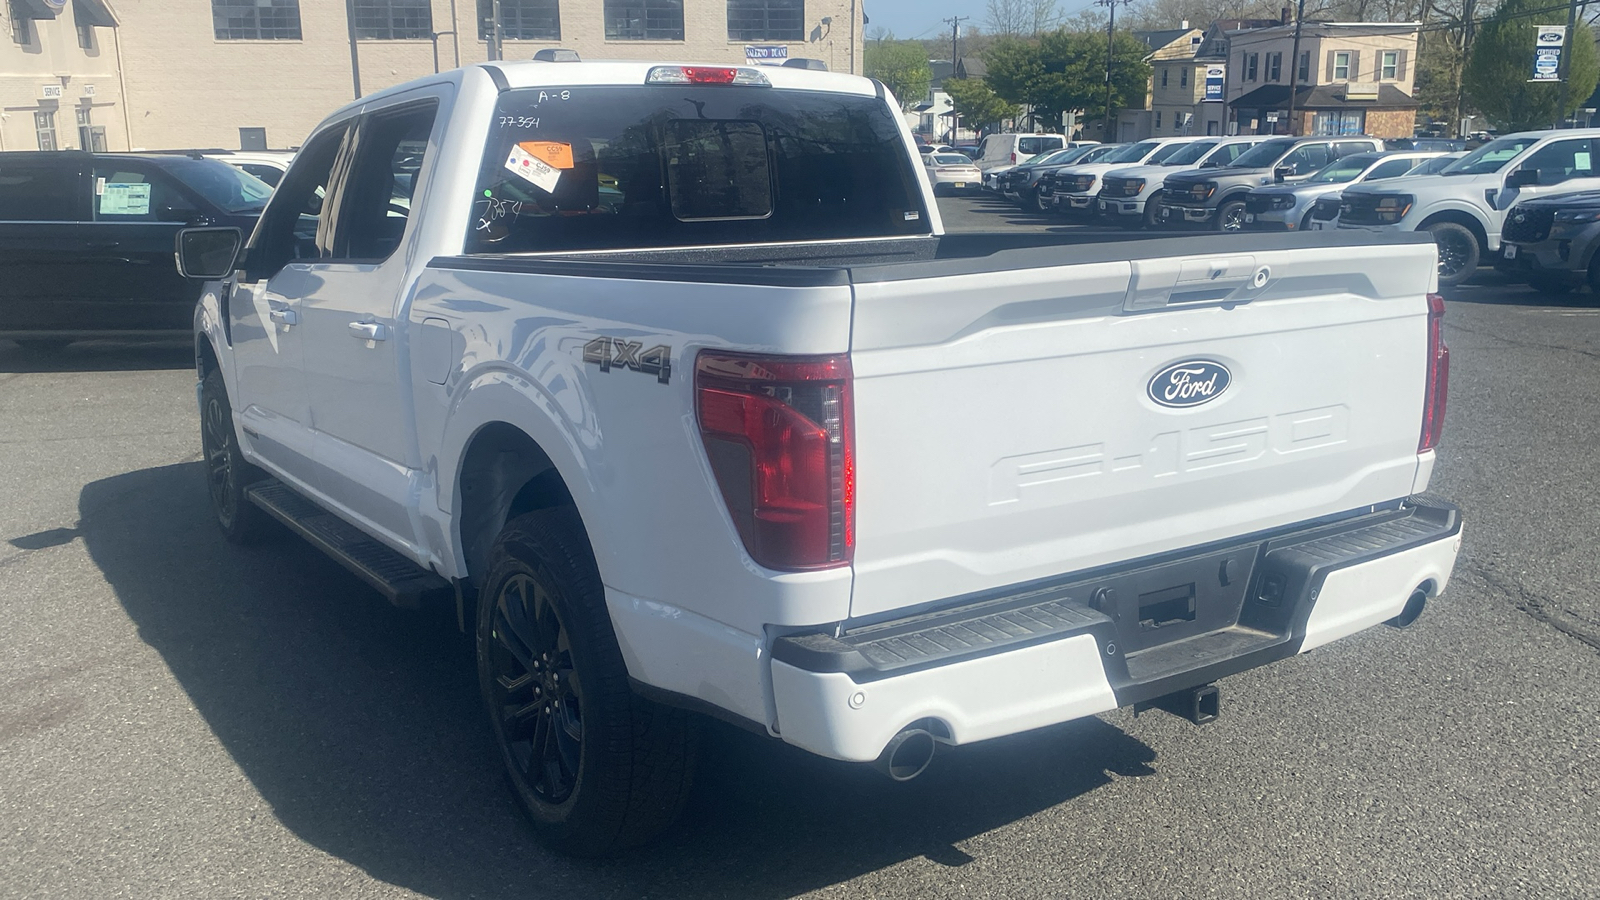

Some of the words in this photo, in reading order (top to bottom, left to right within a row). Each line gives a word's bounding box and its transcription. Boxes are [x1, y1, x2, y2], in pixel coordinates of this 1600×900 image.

[746, 49, 768, 57] SALERNO
[771, 48, 787, 57] DUANE
[44, 87, 61, 96] SERVICE
[84, 86, 95, 95] PARTS
[1164, 367, 1218, 401] Ford
[988, 402, 1350, 507] F-150
